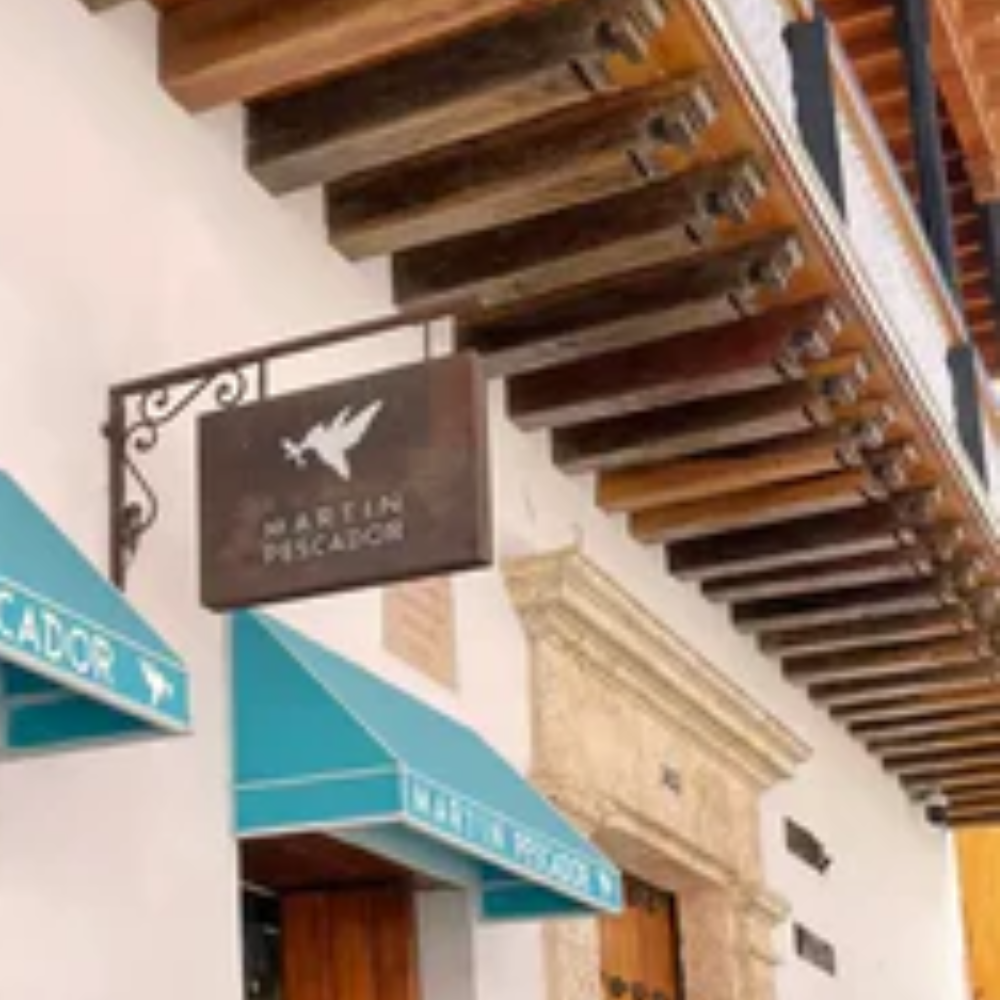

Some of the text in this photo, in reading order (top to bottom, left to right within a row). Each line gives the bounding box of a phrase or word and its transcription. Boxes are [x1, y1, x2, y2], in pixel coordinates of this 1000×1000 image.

[263, 494, 403, 539] MARTIN
[263, 520, 403, 566] PESCADOR
[411, 783, 589, 891] MARTIN PESCADOR
